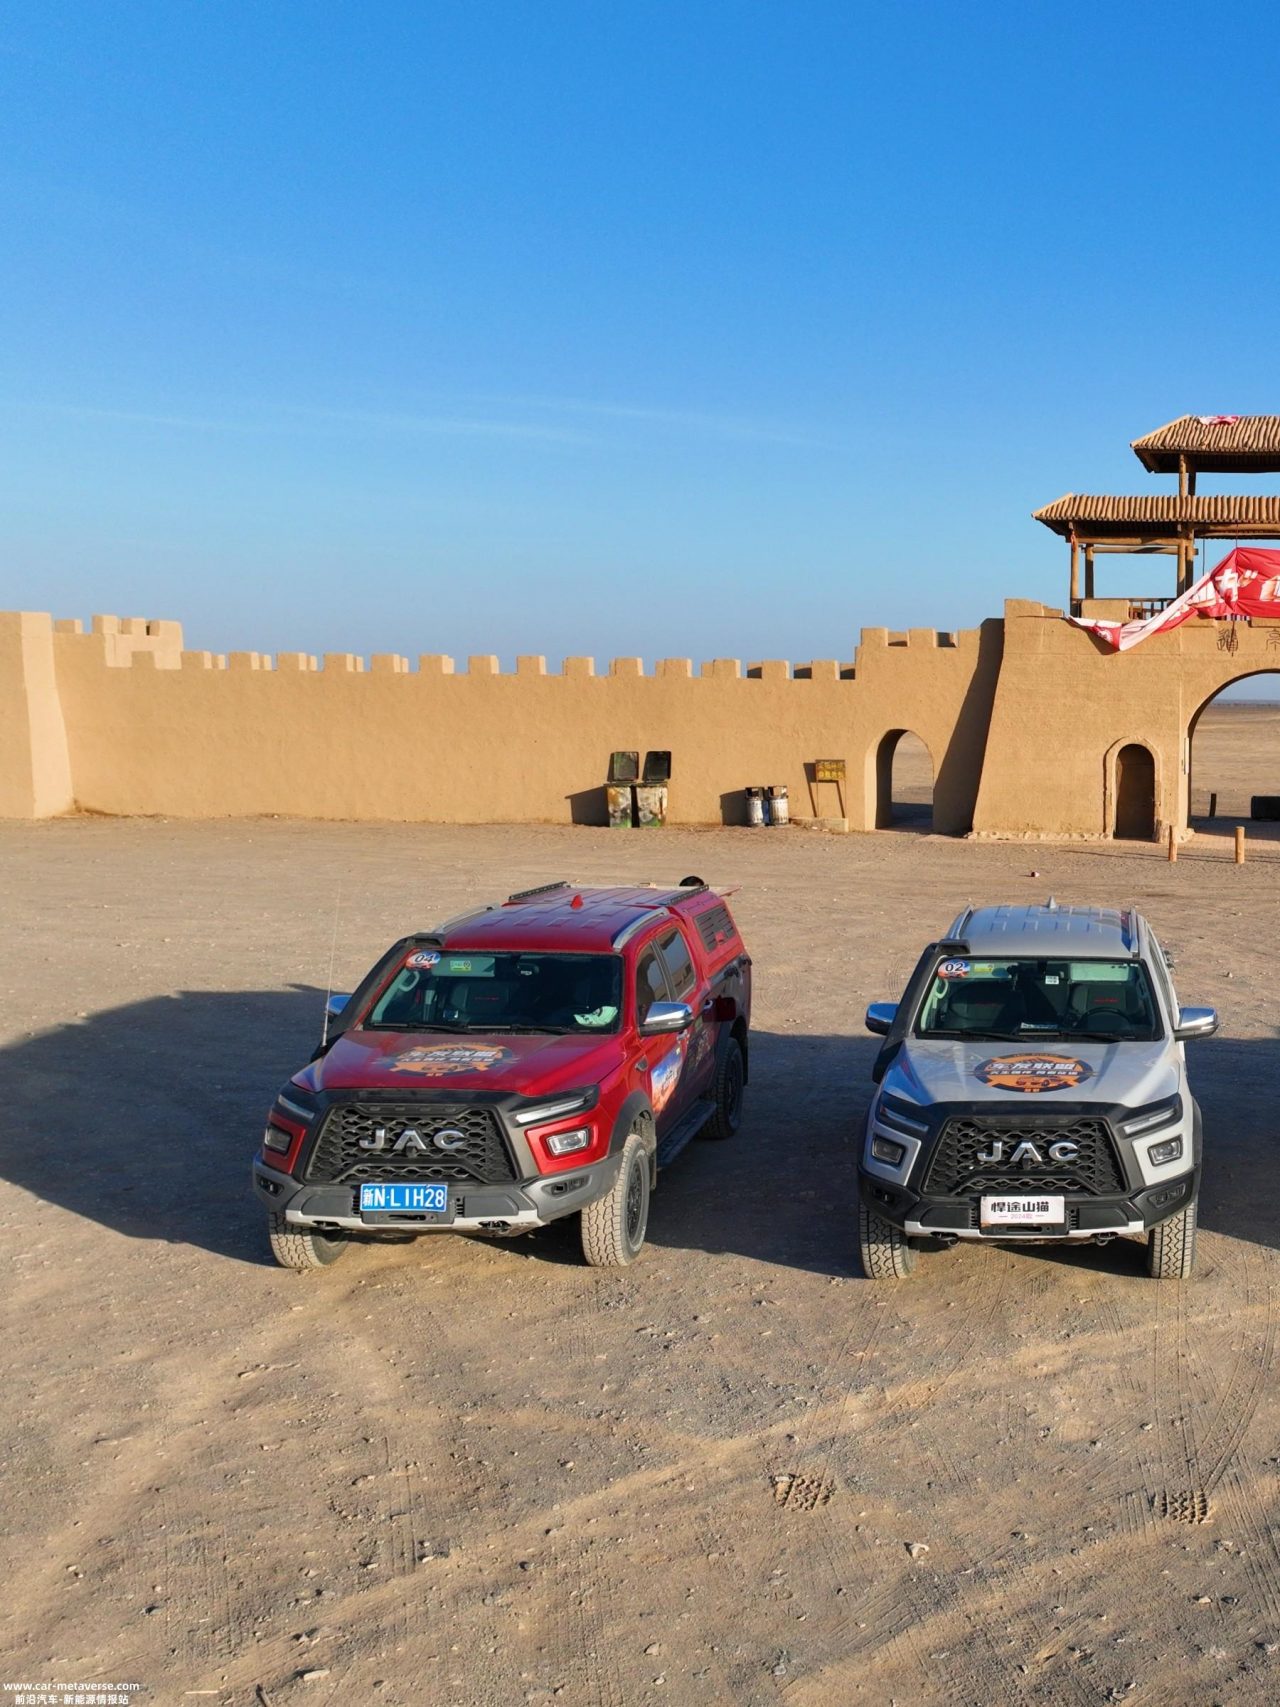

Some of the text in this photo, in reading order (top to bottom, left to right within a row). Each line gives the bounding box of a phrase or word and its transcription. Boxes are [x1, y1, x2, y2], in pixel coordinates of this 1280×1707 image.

[415, 954, 434, 963] 04
[945, 962, 963, 972] 02
[359, 1129, 465, 1150] JAC
[977, 1141, 1079, 1162] JAC
[991, 1201, 1049, 1213] 悍途山猫
